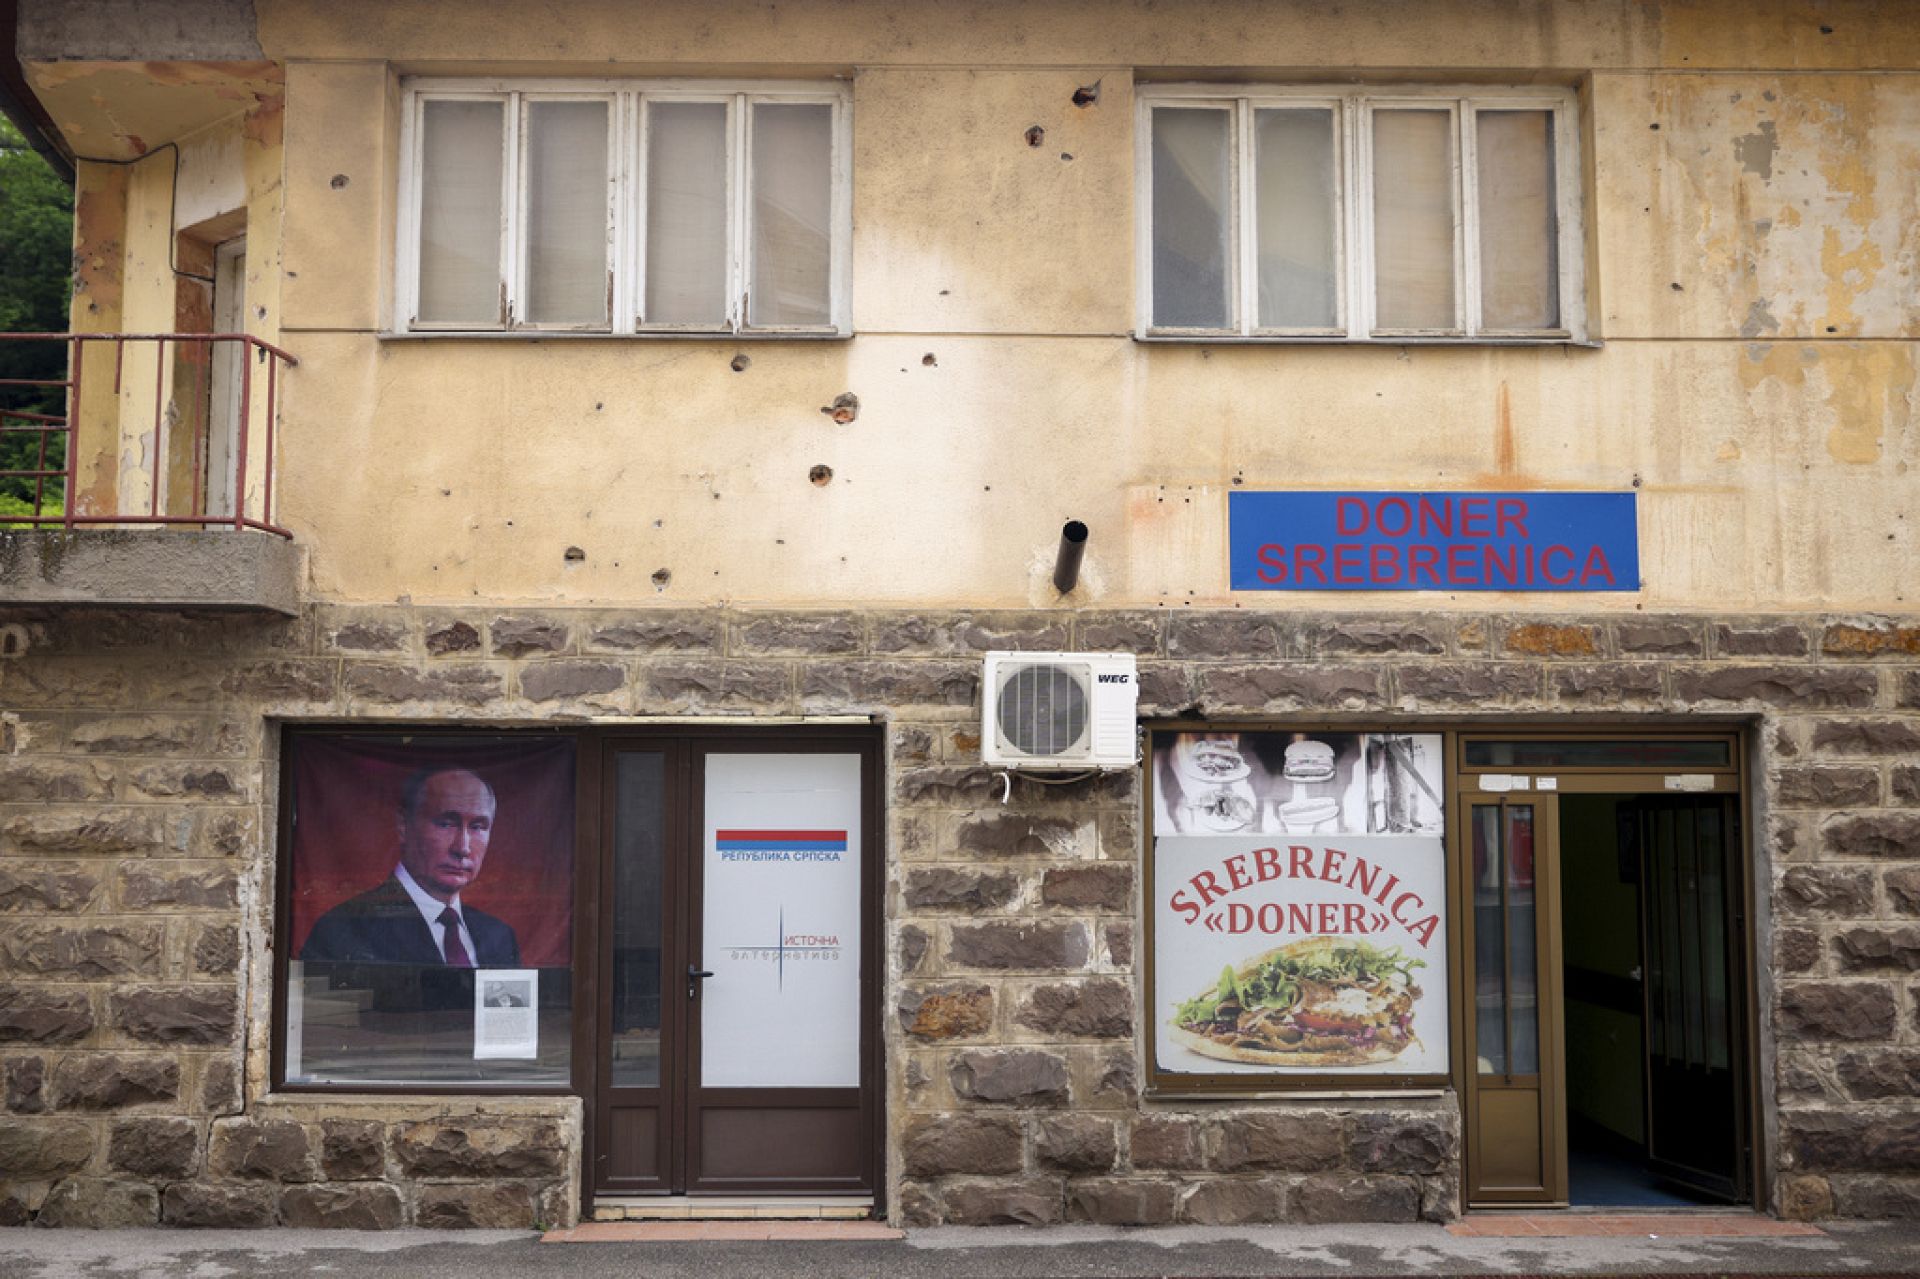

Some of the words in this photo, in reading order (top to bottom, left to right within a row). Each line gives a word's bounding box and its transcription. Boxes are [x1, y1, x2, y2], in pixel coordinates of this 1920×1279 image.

[1335, 496, 1530, 539] DONER
[1256, 543, 1616, 585] SREBRENICA
[1098, 674, 1130, 684] WEG
[721, 852, 791, 862] РЕПУБЛИКА
[792, 852, 841, 862] СРПСКА
[1169, 845, 1440, 949] SREBRENICA
[1204, 903, 1391, 935] «DONER»
[784, 935, 840, 946] ИСТОЧНА
